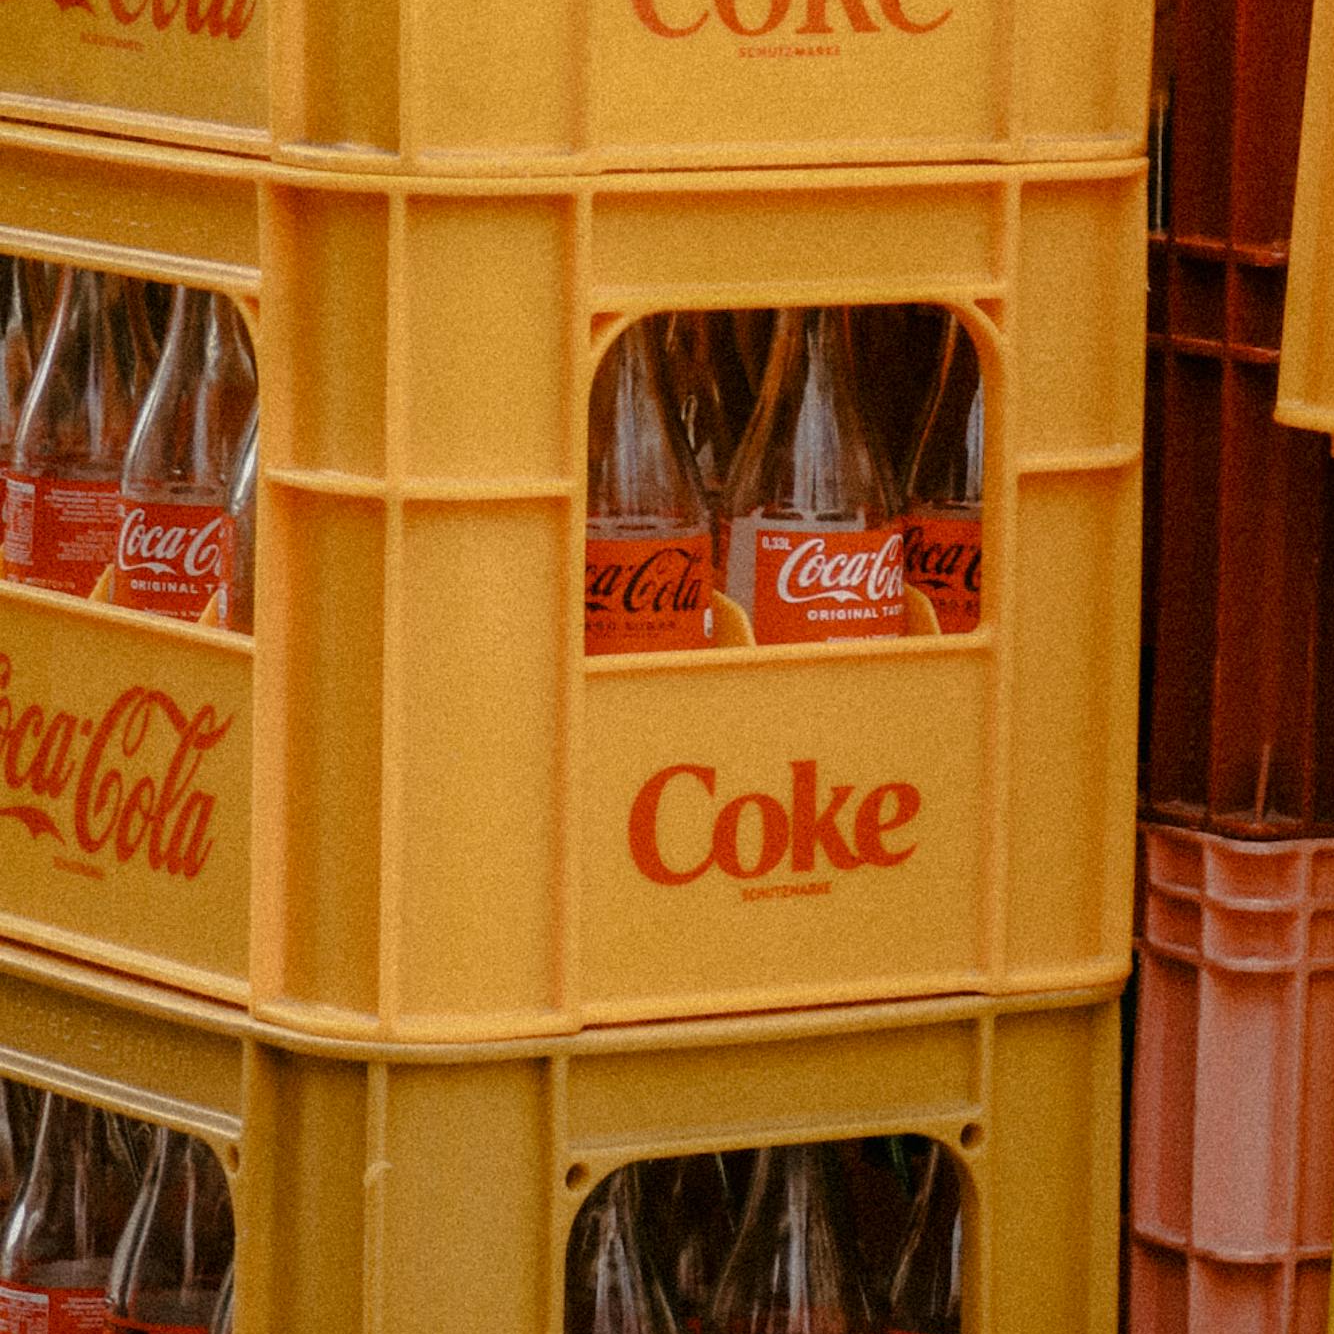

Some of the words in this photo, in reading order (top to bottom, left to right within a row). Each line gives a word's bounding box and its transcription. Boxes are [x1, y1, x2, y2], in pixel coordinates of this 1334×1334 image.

[129, 578, 199, 595] ORIGINAL
[806, 607, 879, 622] ORIGINAL
[627, 759, 922, 887] Coke
